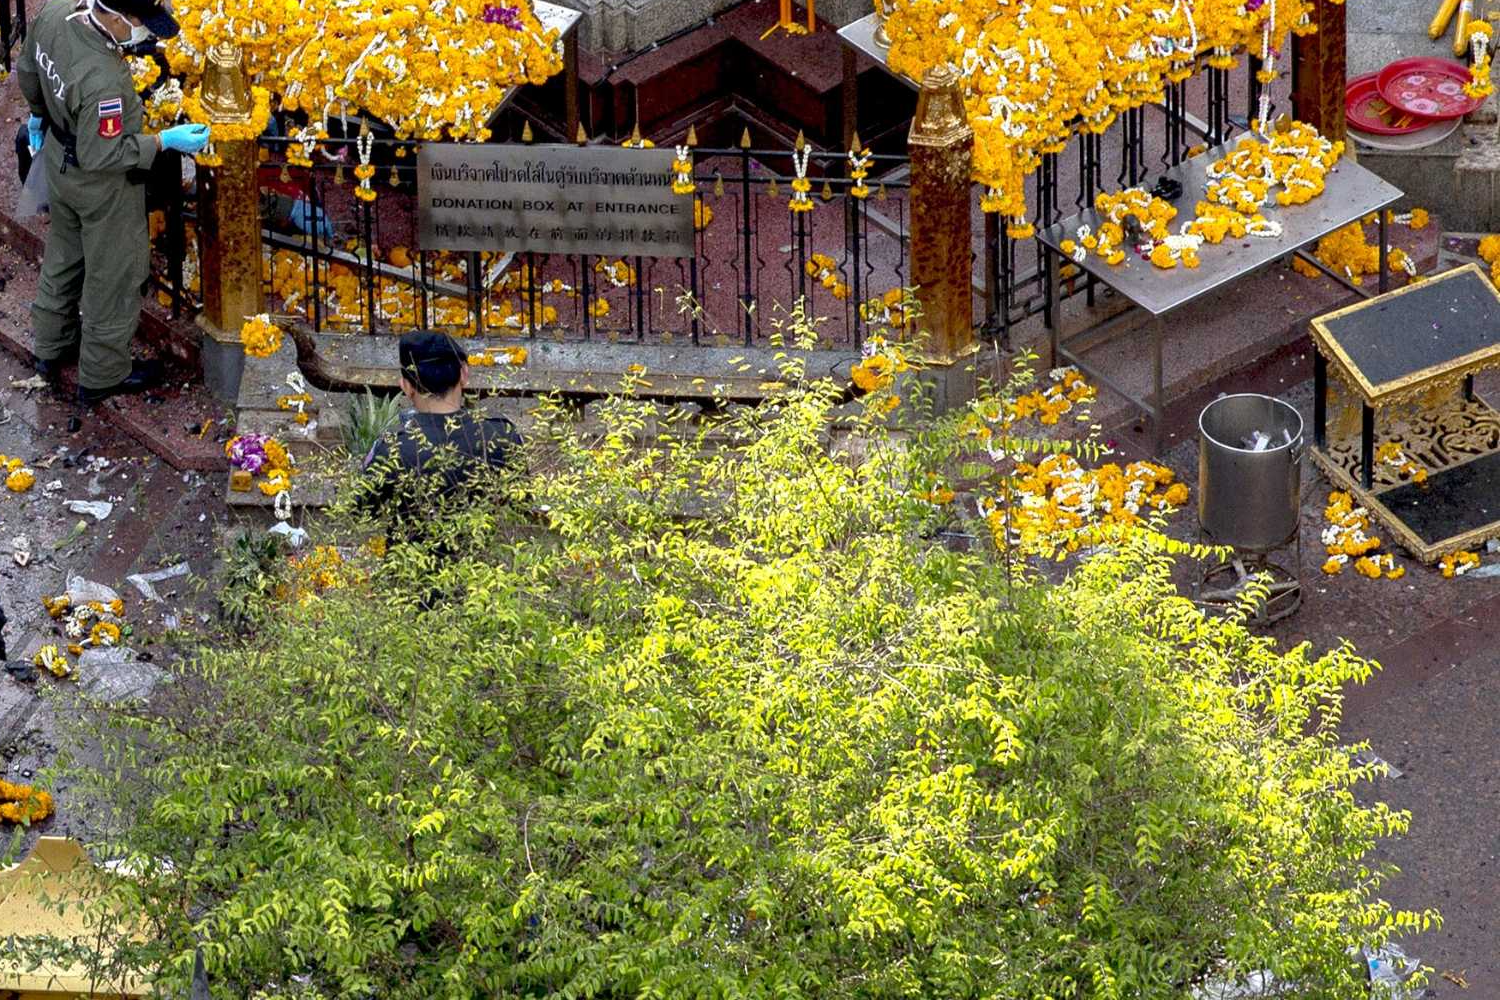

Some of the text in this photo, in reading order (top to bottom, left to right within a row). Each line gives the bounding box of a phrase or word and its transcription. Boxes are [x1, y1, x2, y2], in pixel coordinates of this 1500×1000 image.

[431, 160, 677, 189] เงินบริจาคโปรดใส่ในตู้รับบริจาคด้านหน้
[431, 197, 681, 215] DONATION BOX AT ENTRANCE
